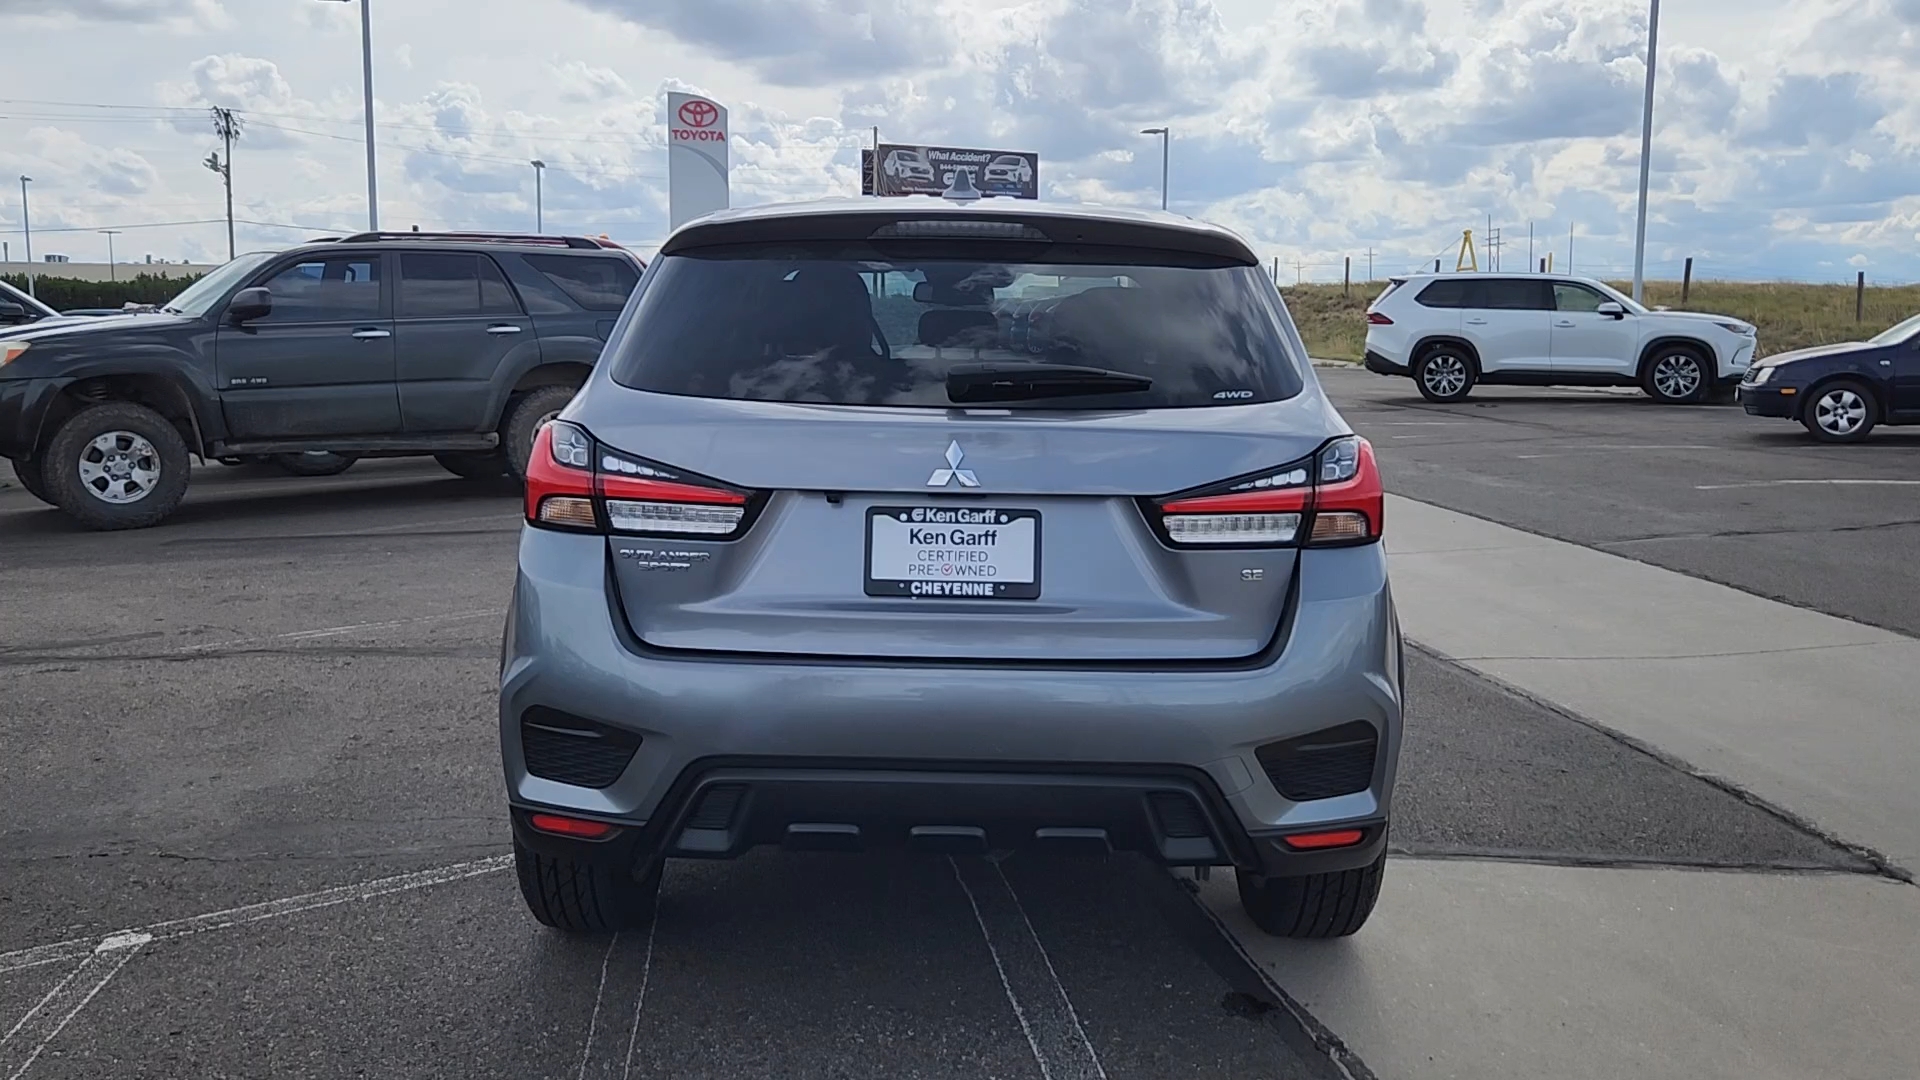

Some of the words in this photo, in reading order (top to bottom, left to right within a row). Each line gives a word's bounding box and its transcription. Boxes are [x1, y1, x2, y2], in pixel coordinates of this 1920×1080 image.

[671, 129, 726, 142] TOYOTA
[928, 150, 950, 160] What
[950, 151, 991, 163] Accident?
[1213, 390, 1254, 399] 4WD
[925, 508, 956, 522] Ken
[957, 509, 997, 523] Garff
[909, 528, 946, 545] Ken
[950, 529, 998, 546] Garff
[619, 548, 711, 562] OUTLANDER
[917, 550, 989, 562] CERTIFIED
[638, 561, 692, 572] SPORT
[1240, 568, 1264, 581] SE
[910, 581, 995, 596] CHEYENNE
